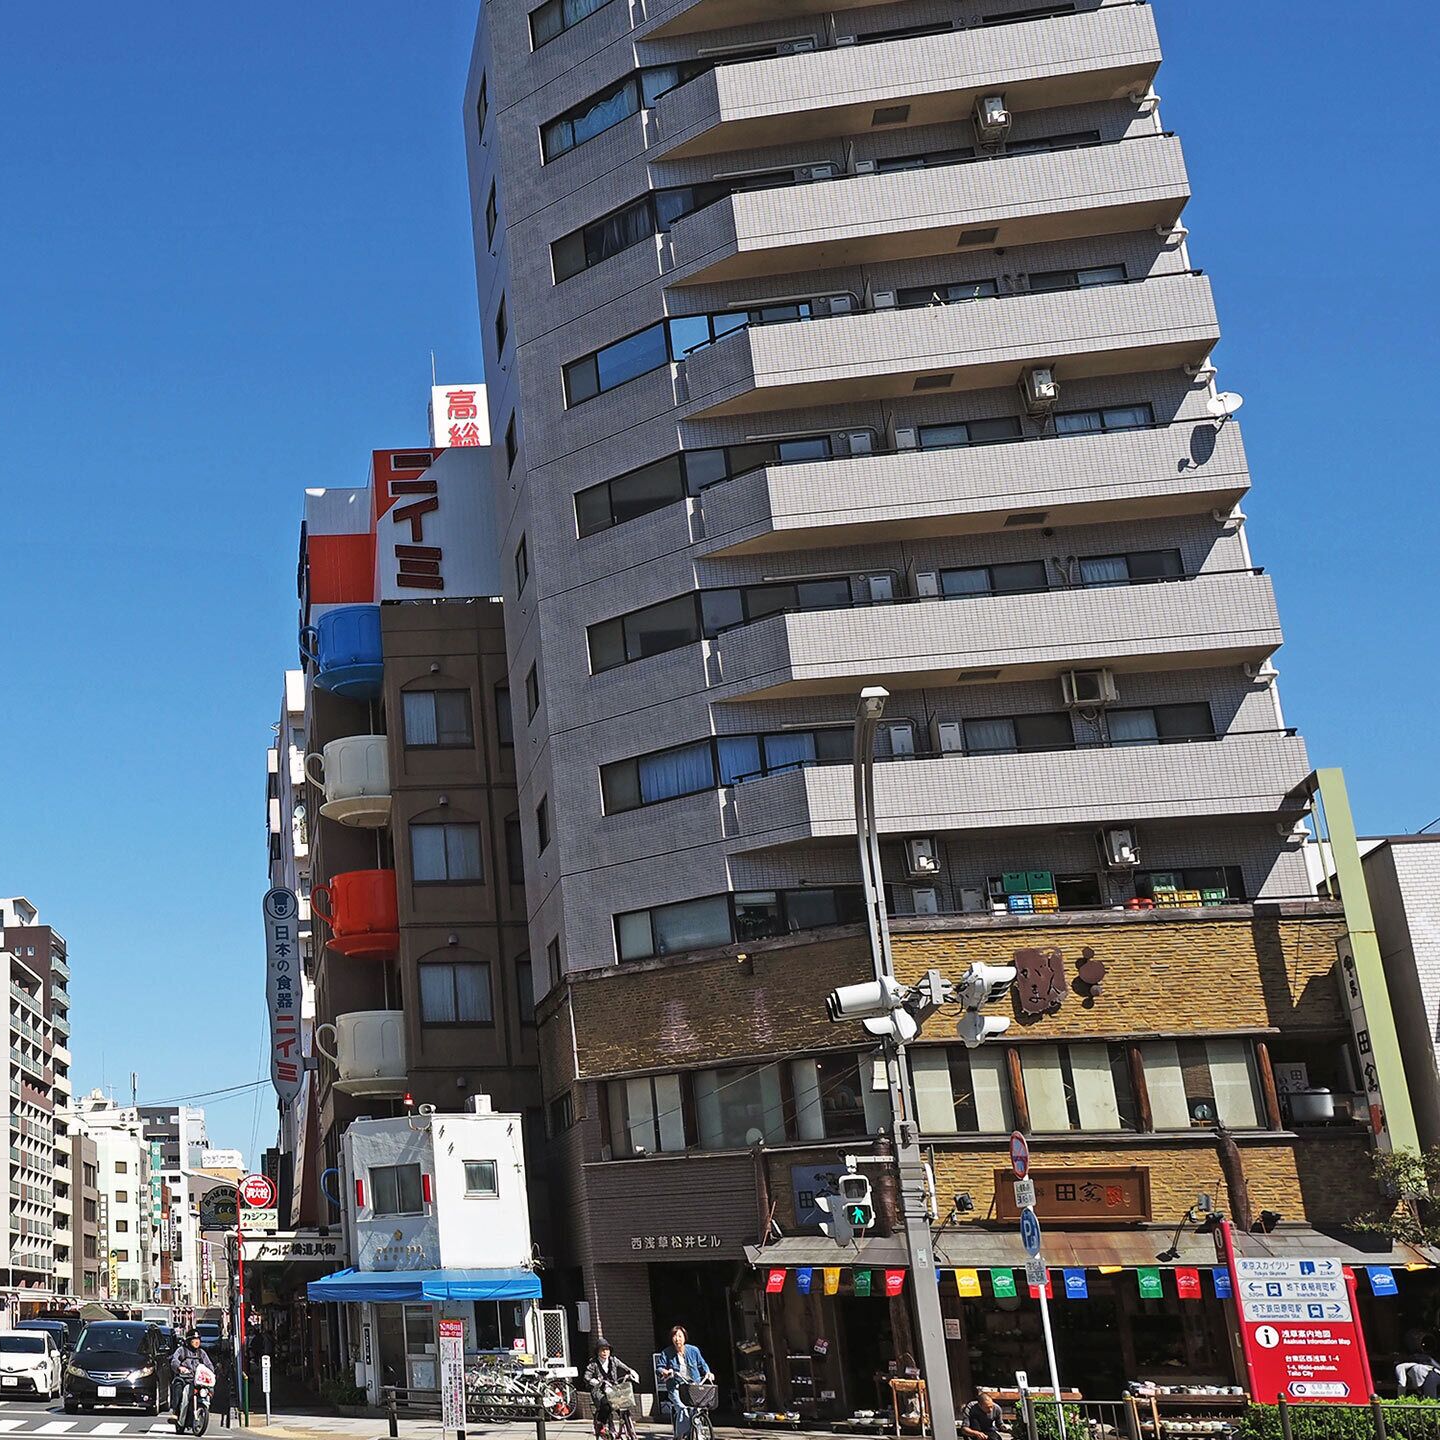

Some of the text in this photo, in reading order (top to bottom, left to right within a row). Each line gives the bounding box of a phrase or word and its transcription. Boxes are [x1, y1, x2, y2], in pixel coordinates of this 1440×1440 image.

[389, 452, 444, 591] ニイミ
[274, 924, 299, 1084] 日本の食器 ニイミ
[246, 1187, 269, 1199] 消火栓
[241, 1212, 277, 1221] カジワラ
[630, 1234, 722, 1250] 西浅草松井ビル
[1242, 1261, 1296, 1271] 東京スカイツリー
[1287, 1282, 1338, 1292] 地下鉄稲荷町駅
[1251, 1303, 1303, 1314] 地下鉄田原町駅
[1281, 1329, 1332, 1338] 浅草案内地図
[1285, 1355, 1328, 1363] 台東区西浅草
